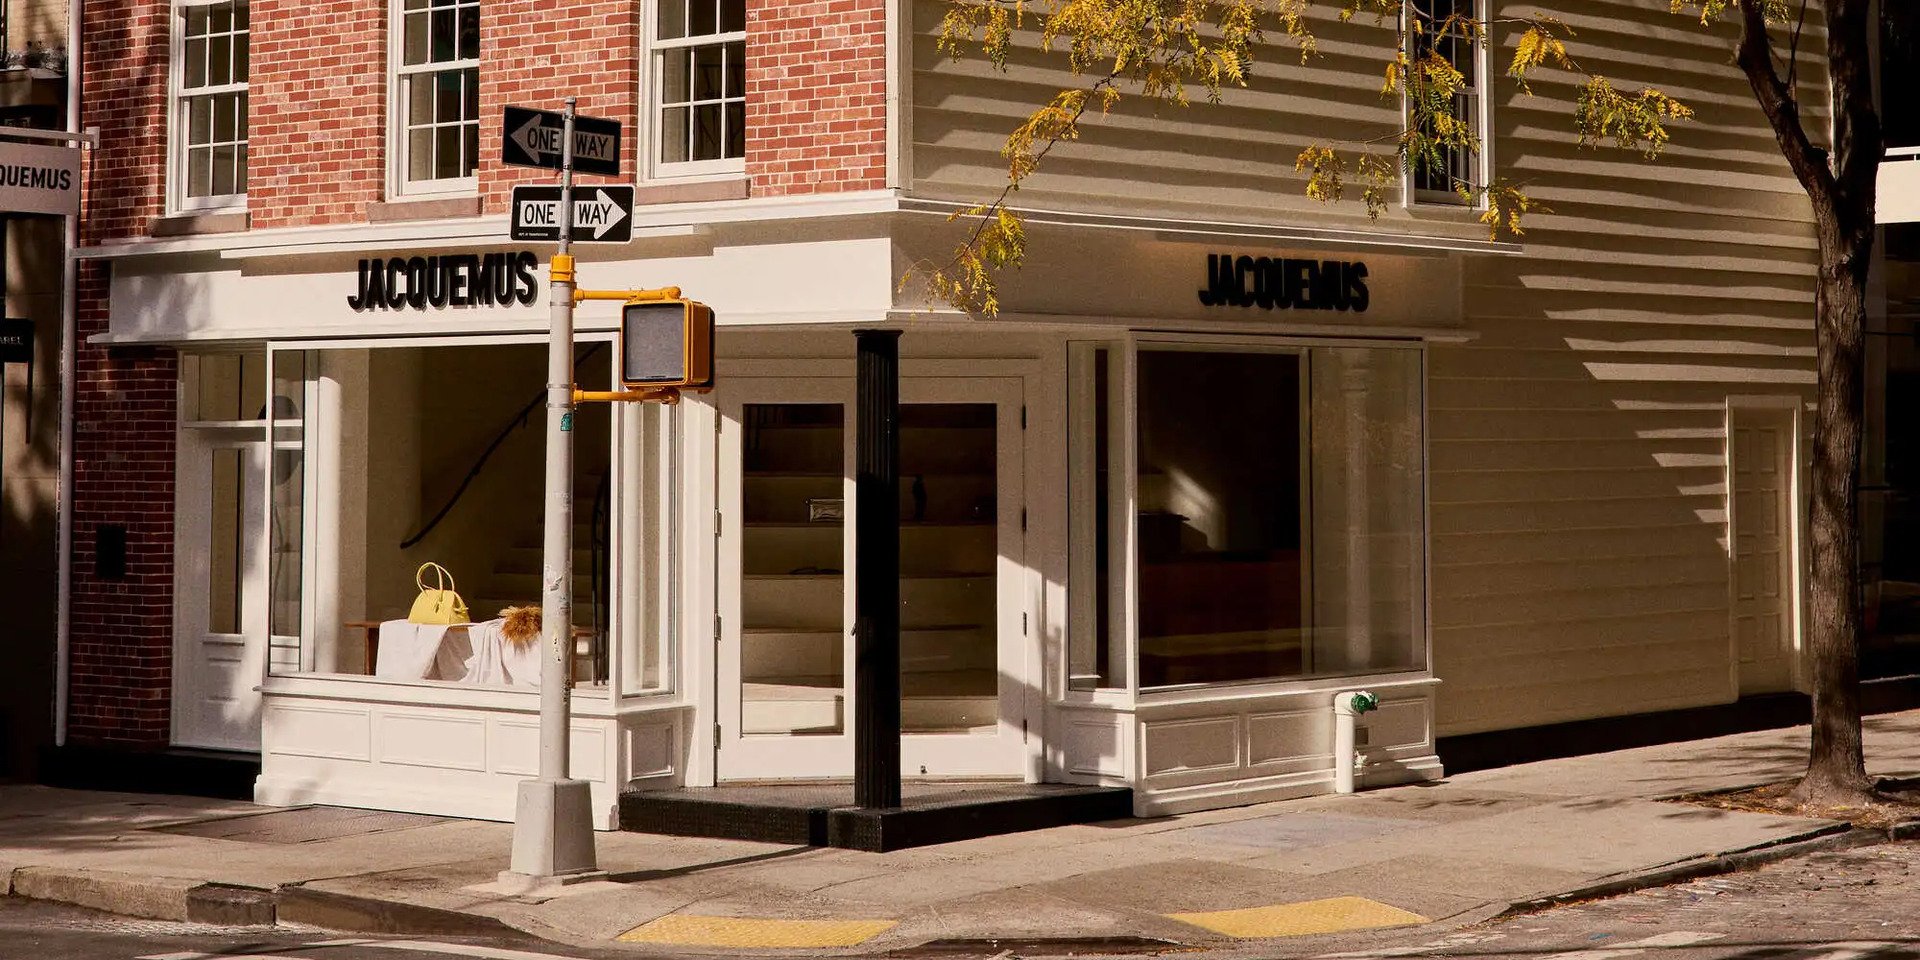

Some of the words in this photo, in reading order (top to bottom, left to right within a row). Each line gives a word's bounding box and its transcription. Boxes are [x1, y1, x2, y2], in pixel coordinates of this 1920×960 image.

[527, 127, 560, 152] ONE
[576, 133, 609, 158] WAY
[524, 203, 556, 224] ONE
[578, 203, 612, 225] WAY
[347, 251, 539, 312] JACQUEMUS
[1198, 254, 1370, 312] JACQUEMUS
